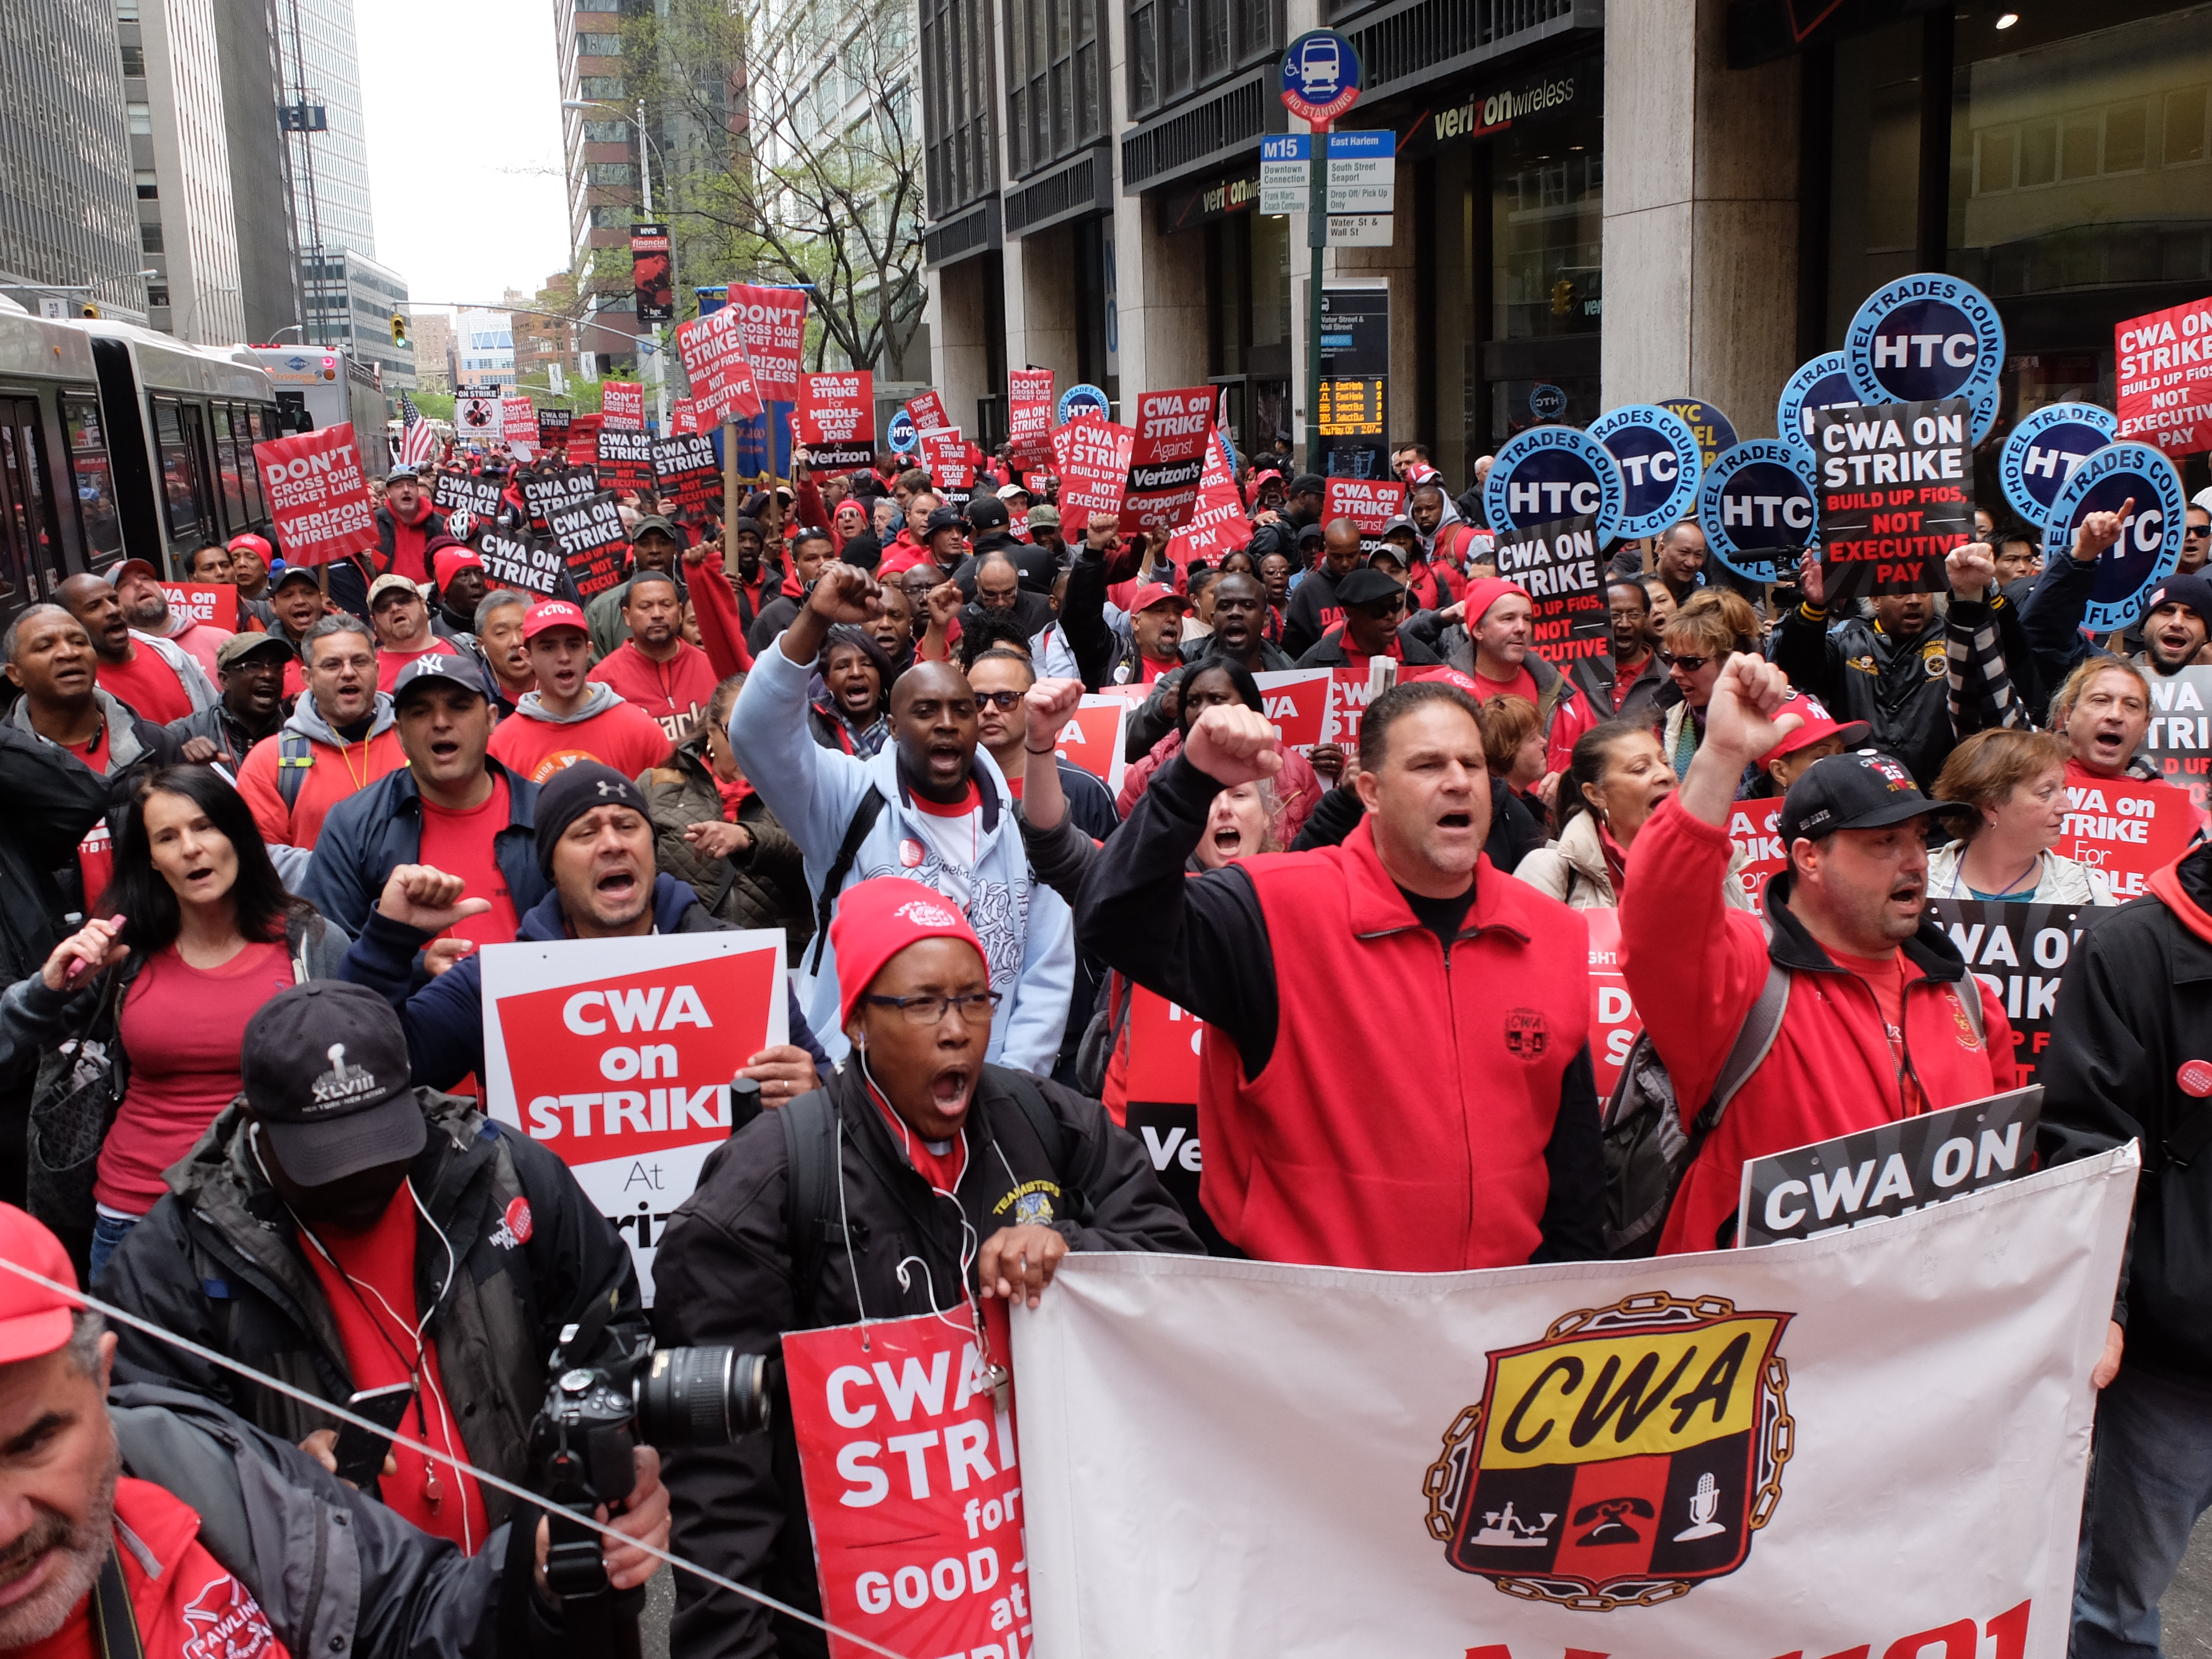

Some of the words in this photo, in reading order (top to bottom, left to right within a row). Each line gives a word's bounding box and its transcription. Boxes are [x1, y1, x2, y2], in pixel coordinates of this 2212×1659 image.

[1287, 94, 1301, 109] NO
[1302, 93, 1352, 117] STANDING
[1264, 139, 1297, 158] M15
[1331, 137, 1348, 147] East
[1350, 136, 1379, 145] Harlem
[1332, 163, 1352, 172] South
[1354, 163, 1376, 171] Street
[1332, 173, 1359, 184] Seaport
[1264, 175, 1305, 184] Connection
[1265, 191, 1280, 200] Frank
[1280, 191, 1295, 200] Martz
[1331, 190, 1347, 200] Drop
[1363, 189, 1376, 197] Pick
[1378, 189, 1388, 198] Up
[1331, 200, 1345, 210] Only
[1264, 202, 1280, 211] Coach
[1281, 201, 1305, 212] Company
[1331, 218, 1354, 227] Water
[1358, 218, 1367, 227] St
[1371, 217, 1378, 226] &
[1331, 228, 1347, 236] Wall
[1350, 228, 1359, 236] St
[632, 238, 667, 248] financial
[680, 324, 710, 350] CWA
[713, 311, 737, 333] ON
[774, 325, 799, 339] OUR
[1851, 321, 1877, 394] HOTEL
[1867, 280, 1957, 317] TRADES
[1960, 294, 1998, 386] COUNCIL
[2120, 322, 2178, 354] CWA
[686, 328, 740, 371] STRIKE
[774, 337, 799, 349] LINE
[1875, 333, 1977, 369] HTC
[2120, 333, 2212, 380] STRIKE
[689, 364, 712, 384] BUILD
[708, 371, 726, 390] NOT
[810, 376, 841, 388] CWA
[842, 376, 859, 386] on
[1011, 379, 1051, 389] DON'T
[2121, 375, 2161, 398] BUILD
[2163, 372, 2183, 387] UP
[604, 390, 640, 404] DON'T
[695, 378, 752, 414] EXECUTIVE
[812, 387, 858, 398] STRIKE
[828, 398, 844, 408] For
[2152, 387, 2191, 410] NOT
[810, 408, 864, 420] MIDDLE-
[1013, 408, 1031, 421] CWA
[1032, 405, 1045, 417] ON
[1143, 396, 1184, 418] CWA
[1188, 395, 1211, 412] on
[604, 415, 639, 425] VERIZON
[817, 419, 857, 430] CLASS
[1011, 416, 1045, 433] STRIKE
[1143, 413, 1206, 440] STRIKE
[2122, 402, 2212, 435] EXECUTIV
[599, 434, 630, 447] CWA
[634, 434, 651, 447] ON
[822, 429, 853, 442] JOBS
[893, 426, 914, 437] HTC
[1074, 425, 1115, 448] CWA
[1823, 419, 1905, 453] CWA
[1913, 414, 1963, 445] ON
[2158, 425, 2194, 448] PAY
[599, 447, 651, 461] STRIKE
[652, 441, 687, 460] CWA
[689, 436, 712, 452] ON
[940, 450, 965, 458] STRIKE
[1021, 440, 1037, 448] NOT
[1150, 437, 1194, 462] Against
[2004, 431, 2031, 493] HOTEL
[2028, 408, 2109, 433] TRADES
[267, 445, 354, 486] DON'T
[655, 449, 716, 476] STRIKE
[808, 449, 870, 466] Verizon
[1659, 417, 1695, 495] COUNCIL
[1714, 445, 1791, 478] TRADES
[1070, 465, 1099, 479] BUILD
[1101, 469, 1115, 481] UP
[1133, 461, 1201, 488] Verizon's
[1824, 448, 1964, 488] STRIKE
[272, 475, 325, 498] CROSS
[327, 465, 359, 486] OUR
[439, 476, 473, 495] CWA
[477, 484, 500, 501] ON
[525, 480, 566, 499] CWA
[568, 474, 595, 493] ON
[1091, 481, 1117, 497] NOT
[1332, 483, 1373, 500] CWA
[1383, 488, 1399, 500] on
[1501, 431, 1580, 465] TRADES
[1584, 445, 1620, 533] COUNCIL
[275, 487, 327, 510] PICKET
[331, 478, 363, 497] LINE
[435, 490, 497, 517] STRIKE
[1126, 488, 1196, 513] Corporate
[1509, 481, 1601, 514] HTC
[1827, 492, 1884, 512] BUILD
[1888, 489, 1915, 506] UP
[280, 500, 369, 535] VERIZON
[552, 511, 589, 536] CWA
[592, 500, 618, 523] ON
[1332, 499, 1394, 516] STRIKE
[1704, 484, 1728, 549] HOTEL
[1723, 495, 1813, 528] HTC
[2062, 448, 2145, 502] TRADES
[2149, 460, 2179, 572] COUNCIL
[284, 514, 373, 549] WIRELESS
[1872, 511, 1924, 535] NOT
[559, 519, 624, 555] STRIKE
[1188, 528, 1217, 550] PAY
[1829, 533, 1970, 562] EXECUTIVE
[481, 534, 528, 565] CWA
[531, 549, 561, 574] ON
[1498, 538, 1553, 572] CWA
[1554, 529, 1595, 562] ON
[479, 554, 556, 594] STRIKE
[589, 557, 613, 575] NOT
[1876, 562, 1924, 583] PAY
[191, 591, 216, 604] on
[1545, 598, 1564, 615] UP
[1535, 618, 1572, 641] NOT
[416, 654, 444, 676] NY
[1807, 701, 1831, 720] NY
[1881, 764, 1905, 781] 25
[2116, 797, 2156, 818] on
[2074, 840, 2112, 869] For
[562, 985, 713, 1036] CWA
[1509, 1014, 1542, 1032] CWA
[599, 1043, 678, 1082] on
[312, 1074, 375, 1103] XLVIII
[624, 1161, 665, 1192] At
[1765, 1158, 1916, 1232] CWA
[1931, 1122, 2022, 1189] ON
[1500, 1331, 1752, 1454] CWA
[835, 1408, 1016, 1509] STRI
[963, 1487, 1021, 1540] for
[855, 1546, 1000, 1615] GOOD
[990, 1583, 1027, 1631] at
